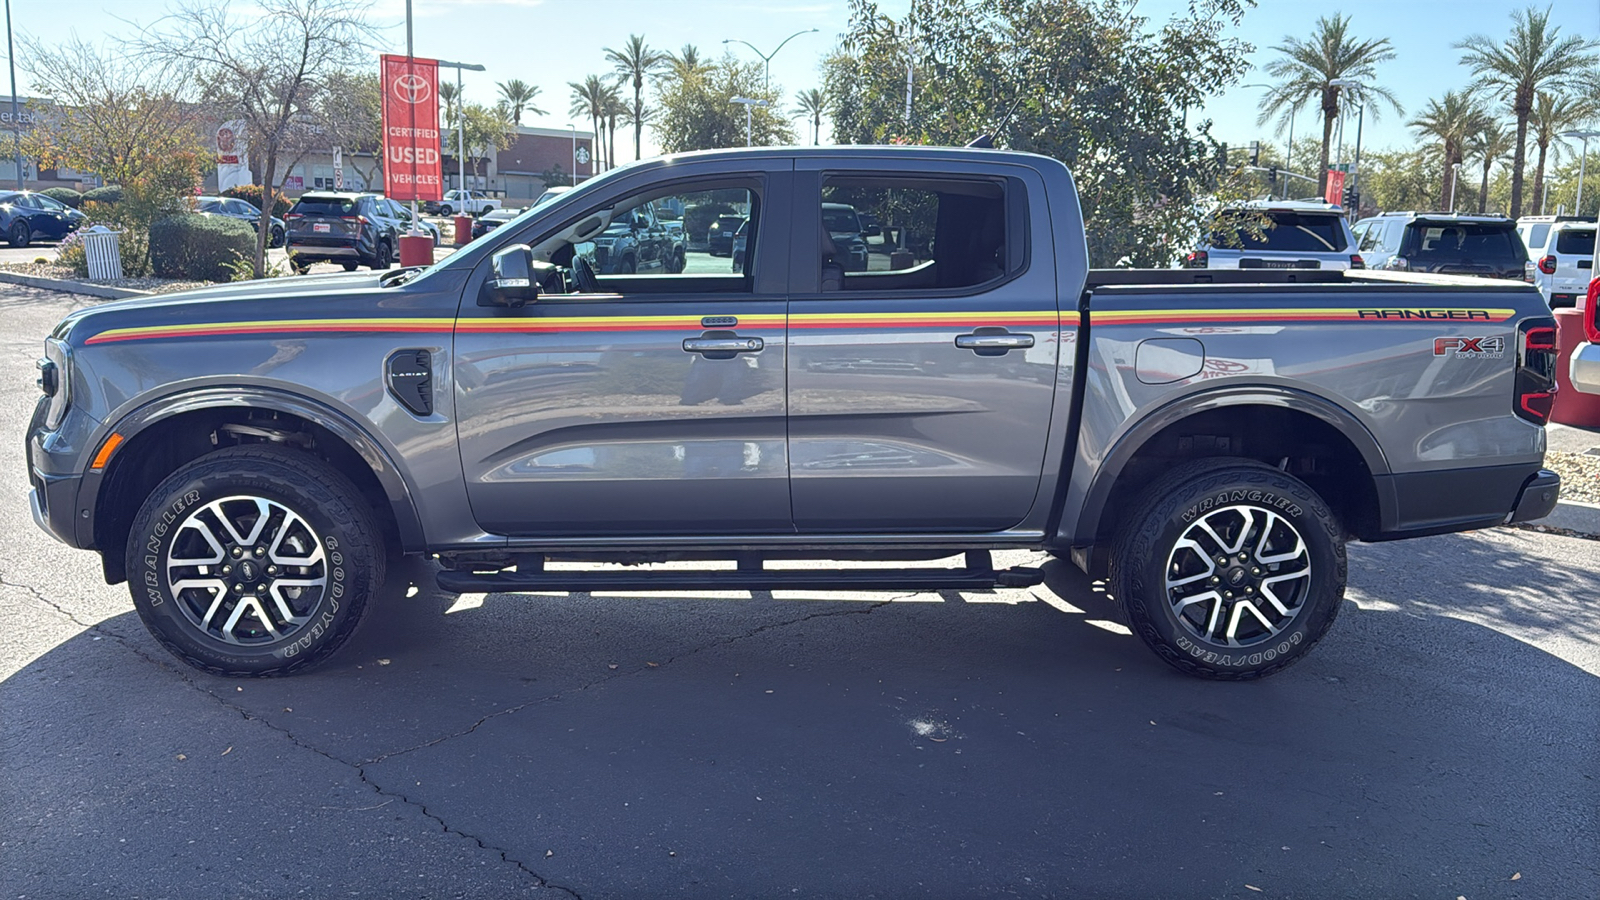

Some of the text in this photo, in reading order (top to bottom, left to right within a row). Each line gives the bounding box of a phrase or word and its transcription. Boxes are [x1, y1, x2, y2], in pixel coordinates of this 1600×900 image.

[389, 126, 438, 139] CERTIFIED
[390, 146, 439, 165] USED
[392, 173, 439, 185] VEHICLES
[1357, 309, 1491, 320] RANGER
[1433, 336, 1505, 356] FX4
[1181, 490, 1303, 523] WRANGLER
[144, 489, 201, 607] WRANGLER
[284, 535, 344, 658] GOODYEAR
[1176, 631, 1303, 667] GOODYEAR
